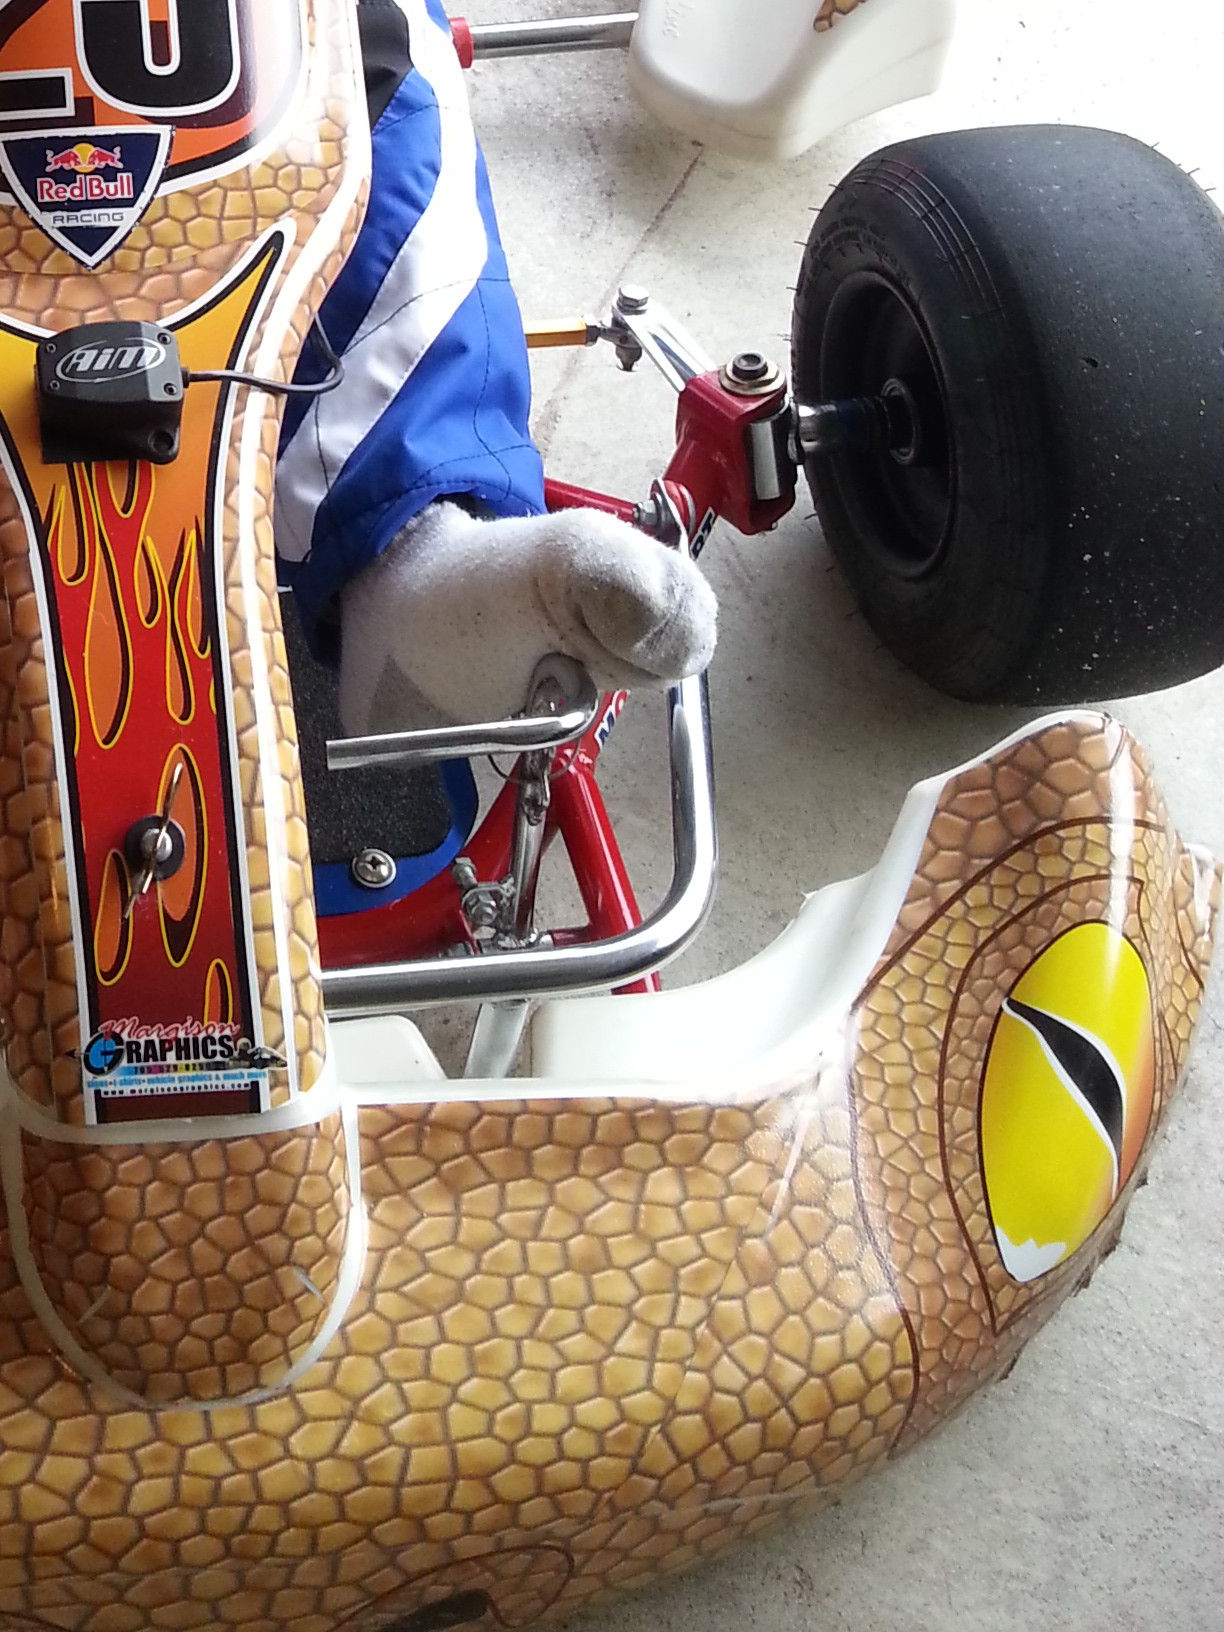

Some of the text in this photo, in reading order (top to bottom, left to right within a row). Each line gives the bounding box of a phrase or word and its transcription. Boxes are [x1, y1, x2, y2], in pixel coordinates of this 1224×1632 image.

[36, 171, 134, 203] Red Bull
[52, 211, 124, 226] RACING
[98, 1016, 241, 1040] Margison
